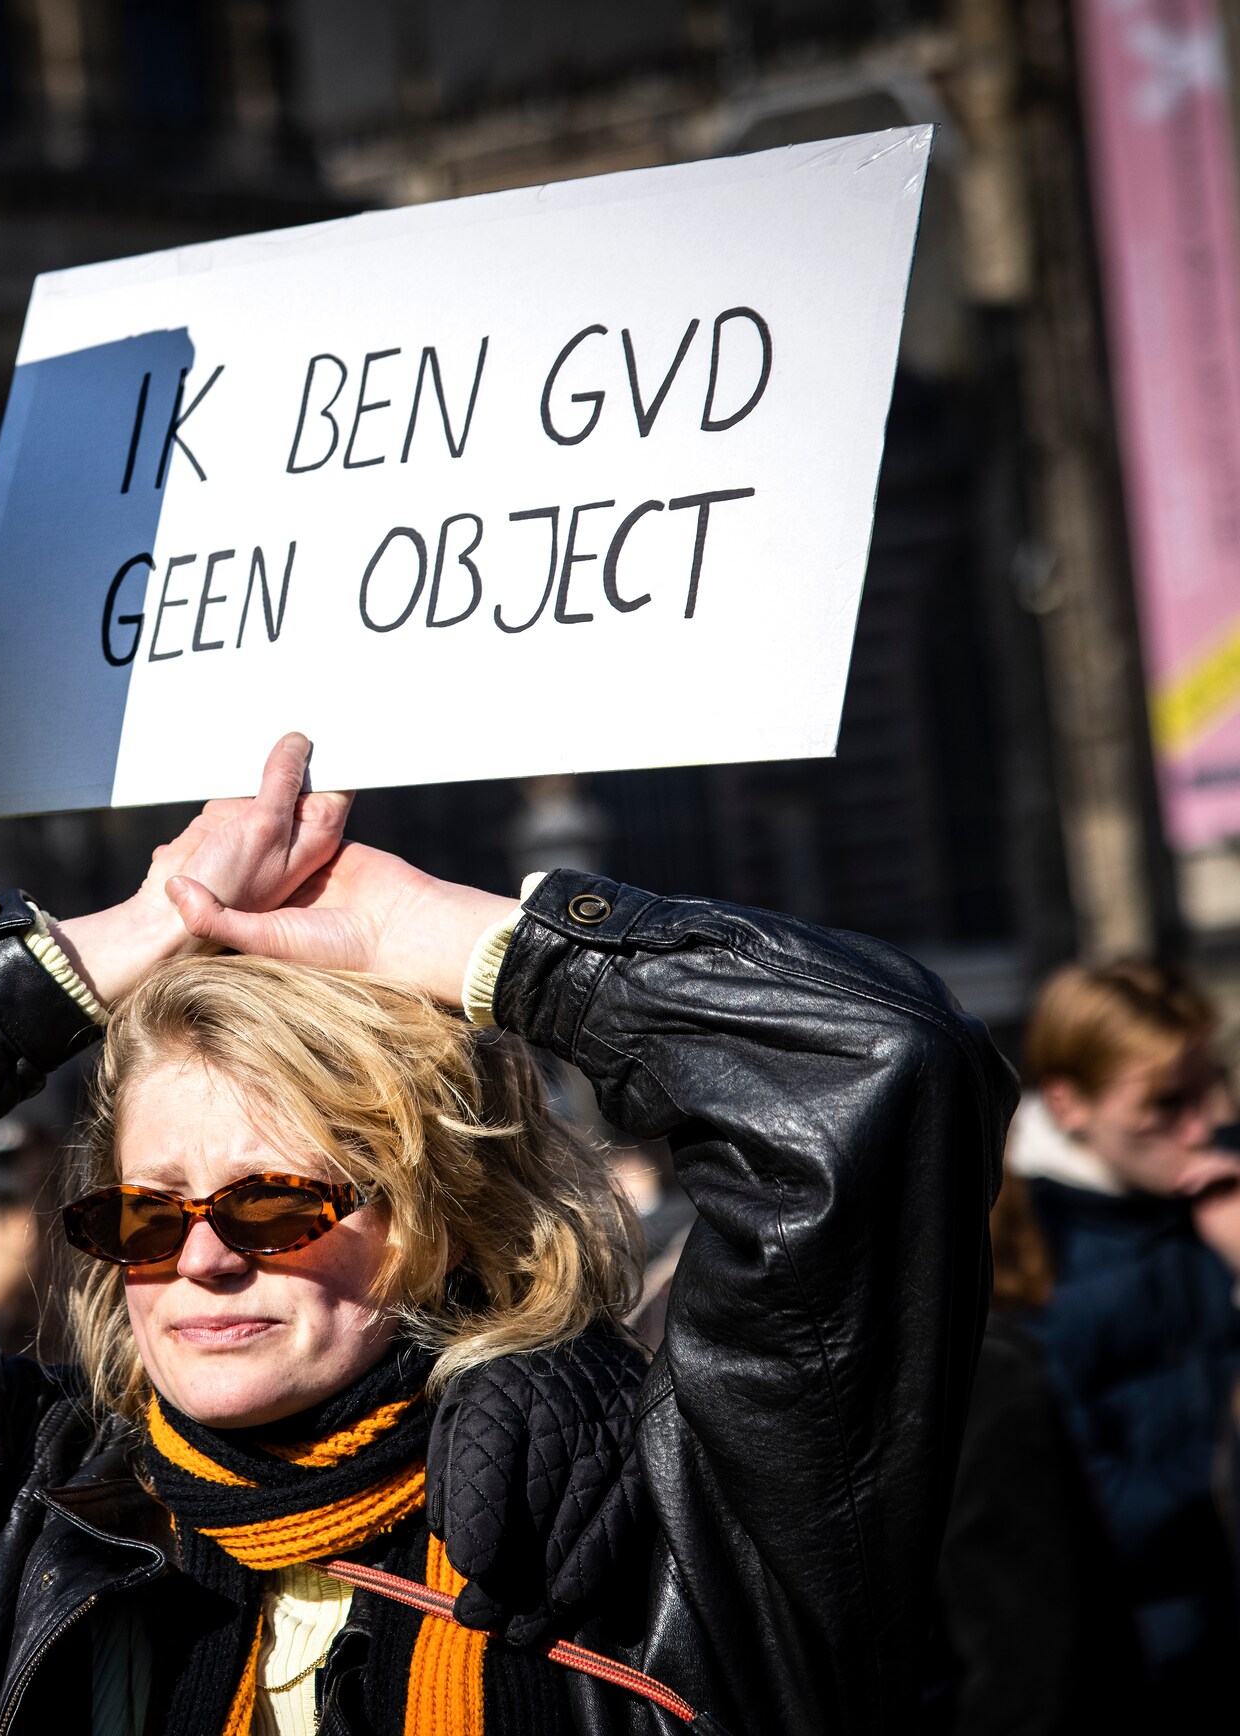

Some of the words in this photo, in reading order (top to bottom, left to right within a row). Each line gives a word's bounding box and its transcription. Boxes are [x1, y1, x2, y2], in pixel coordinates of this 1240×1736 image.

[120, 364, 225, 495] IK
[286, 336, 490, 474] BEN
[539, 306, 773, 446] GVD
[102, 540, 297, 668] GEEN
[359, 487, 756, 635] OBJECT
